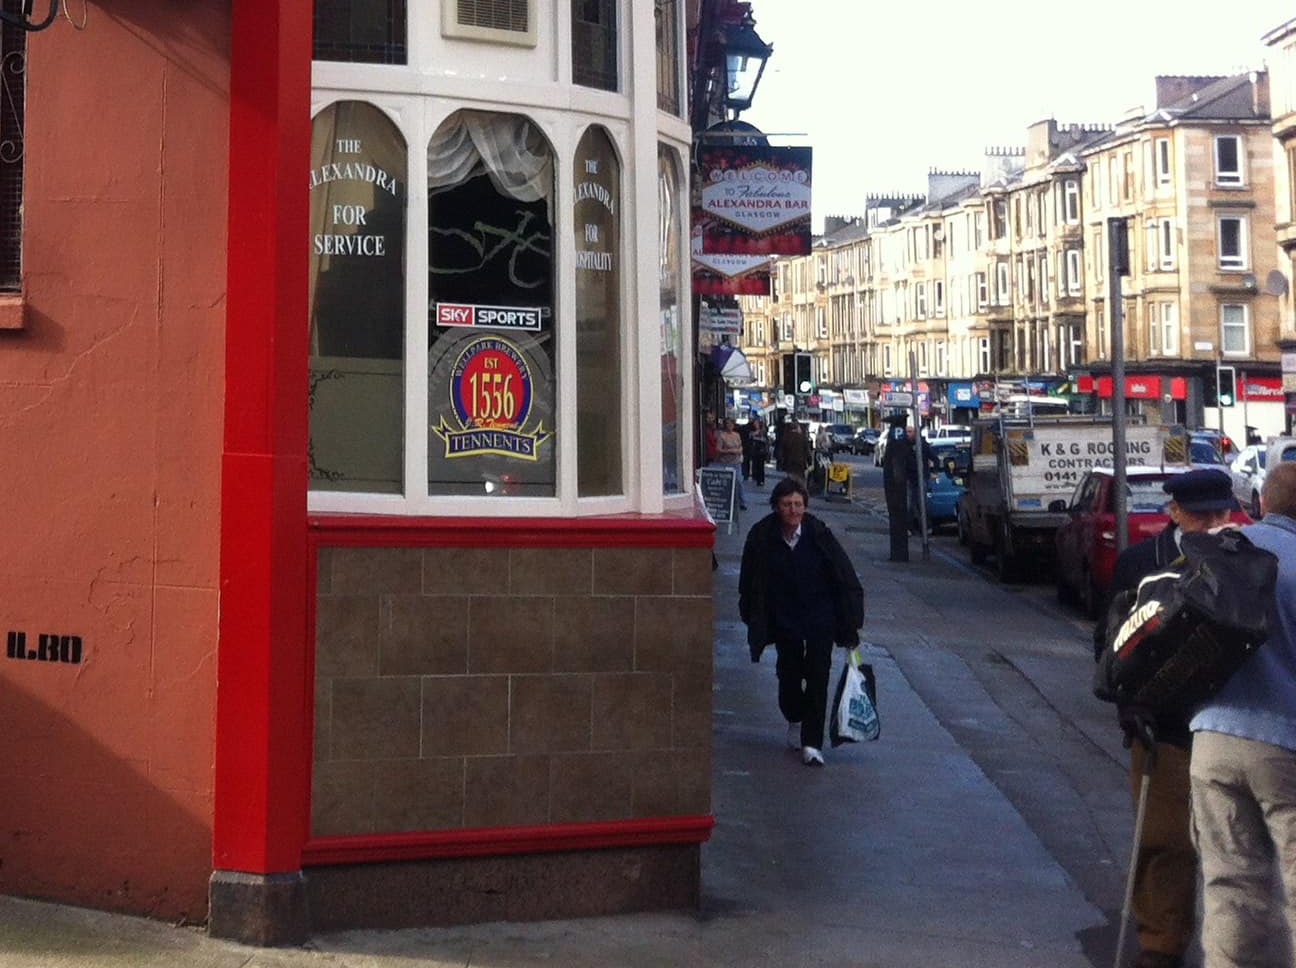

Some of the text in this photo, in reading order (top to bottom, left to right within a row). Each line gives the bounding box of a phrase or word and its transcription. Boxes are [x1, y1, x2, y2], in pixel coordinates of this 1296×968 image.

[336, 139, 361, 153] THE
[585, 159, 599, 174] THE
[309, 162, 397, 195] LEXANDRA
[711, 171, 807, 182] WELCOME
[708, 200, 808, 209] ALEXANDRA BAR
[333, 205, 366, 225] FOR
[585, 223, 599, 243] FOR
[314, 234, 386, 256] SERVICE
[440, 308, 536, 326] SKY SPORTS
[484, 357, 499, 369] EST
[470, 372, 515, 420] 1556
[452, 432, 532, 454] TENNENTS
[1040, 441, 1151, 456] K & G ROOING
[1048, 457, 1146, 469] CONTRACRS
[1044, 471, 1078, 481] 0141
